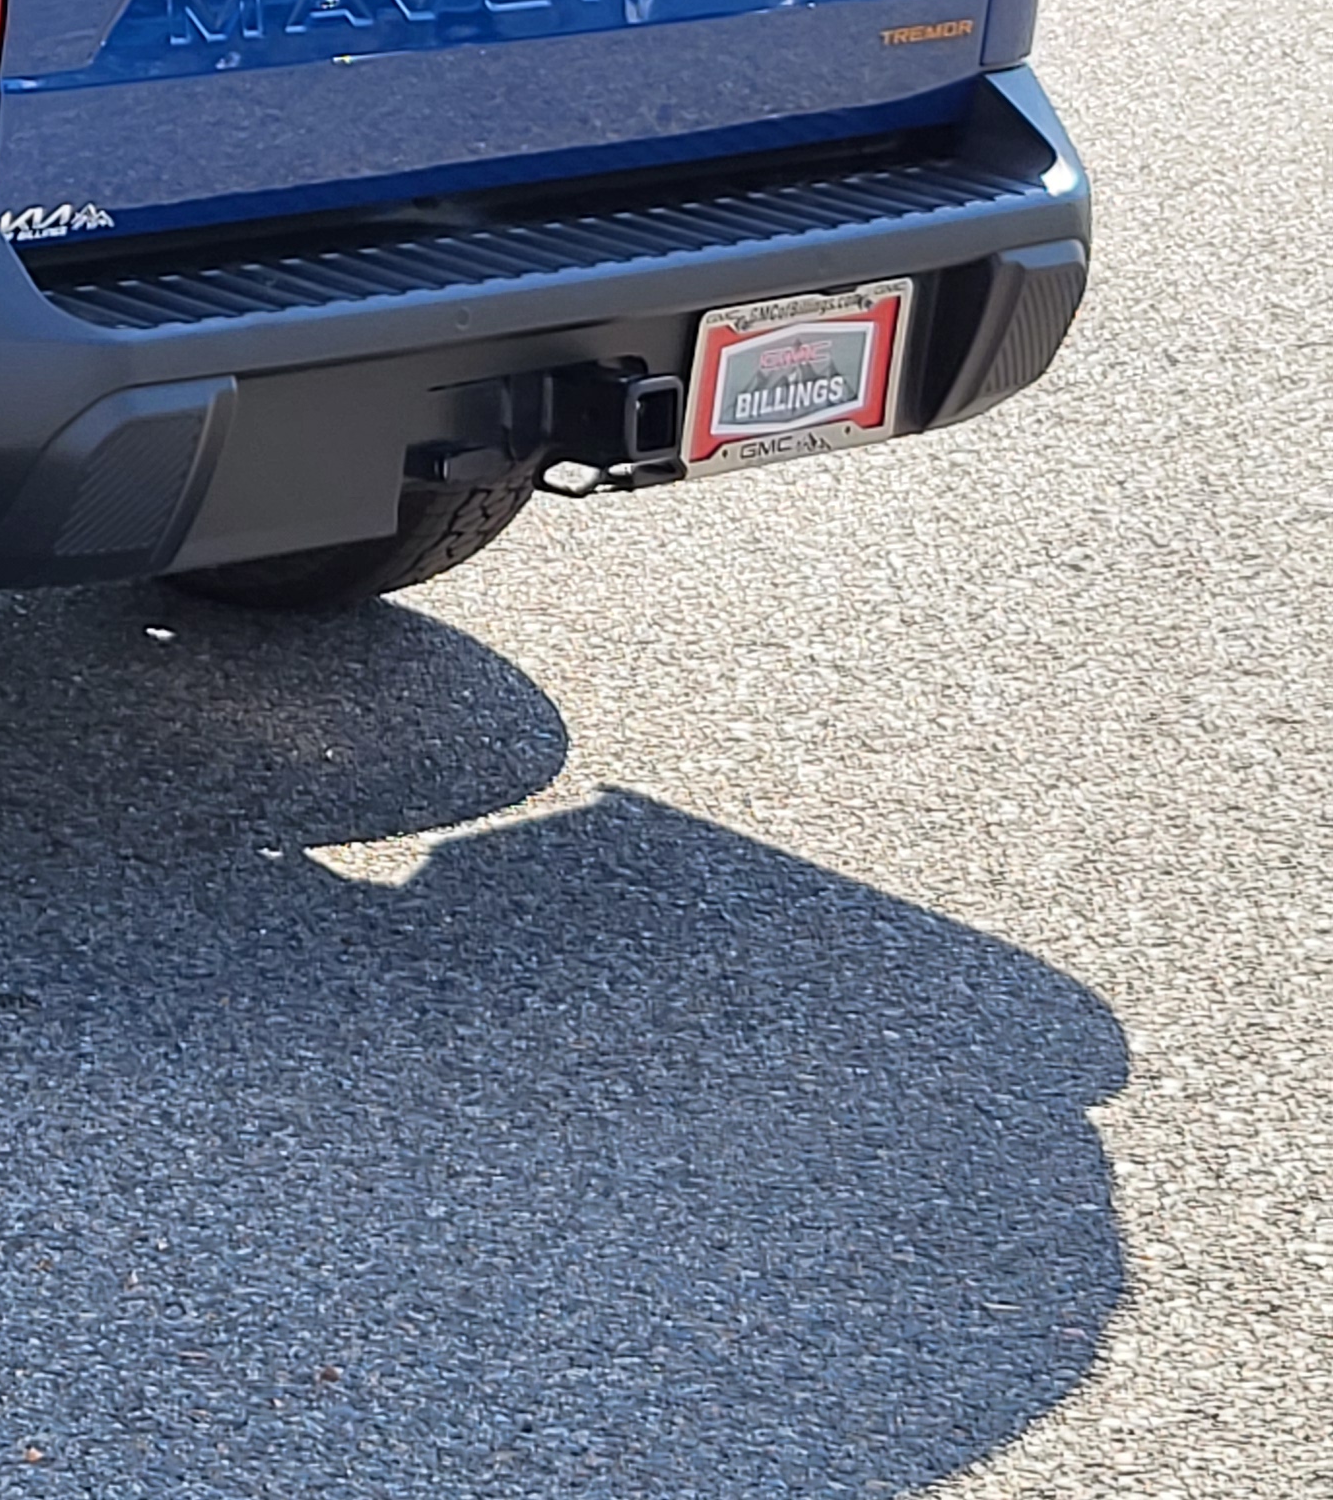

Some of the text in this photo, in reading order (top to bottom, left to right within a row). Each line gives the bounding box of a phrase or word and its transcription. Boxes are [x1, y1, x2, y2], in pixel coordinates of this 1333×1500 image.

[879, 19, 974, 46] TREMOR
[735, 376, 844, 419] BILLINGS
[739, 436, 793, 460] GMC
